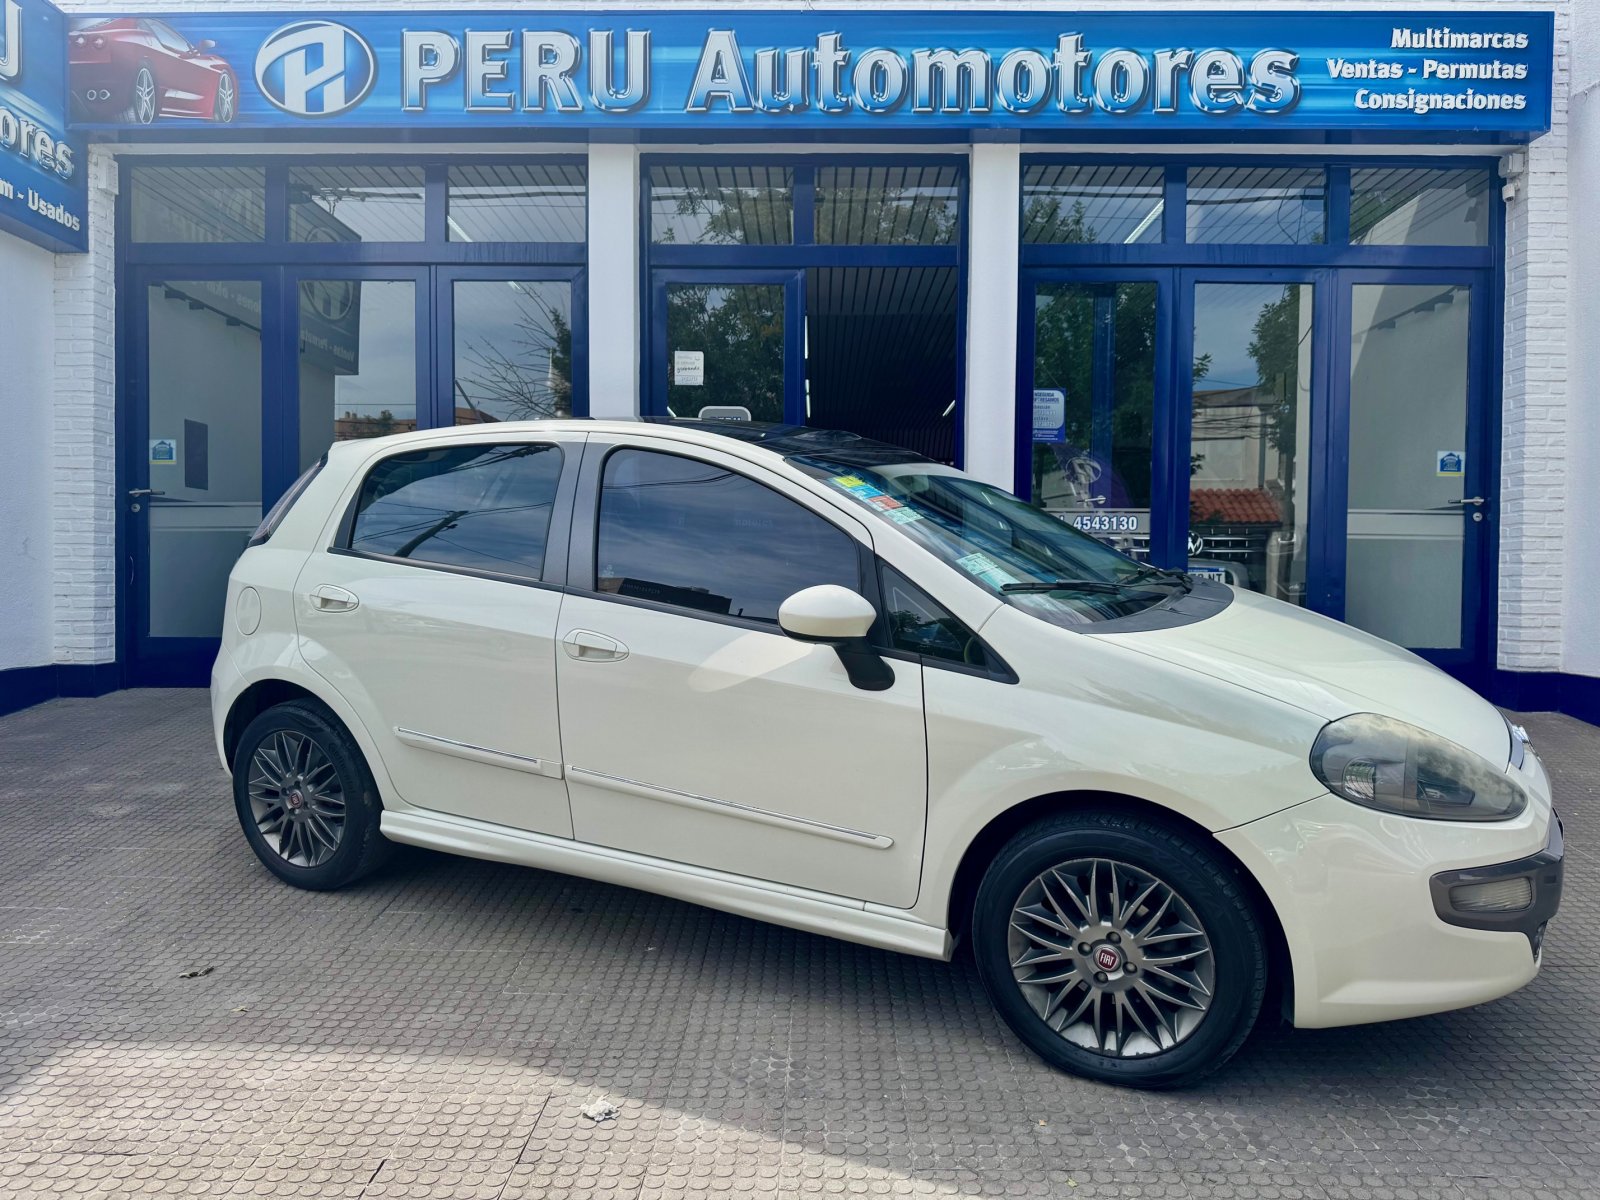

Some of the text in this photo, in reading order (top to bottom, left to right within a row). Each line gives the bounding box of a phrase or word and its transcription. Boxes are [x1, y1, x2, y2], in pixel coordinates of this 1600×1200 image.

[1390, 27, 1529, 49] Multimarcas
[402, 28, 651, 113] PERU
[685, 27, 1301, 115] Automotores
[1327, 58, 1528, 79] Ventas - Permutas
[1354, 88, 1526, 114] Consignaciones
[27, 187, 81, 232] Usados
[1073, 515, 1138, 531] 4543130
[1100, 952, 1115, 966] FIAT
